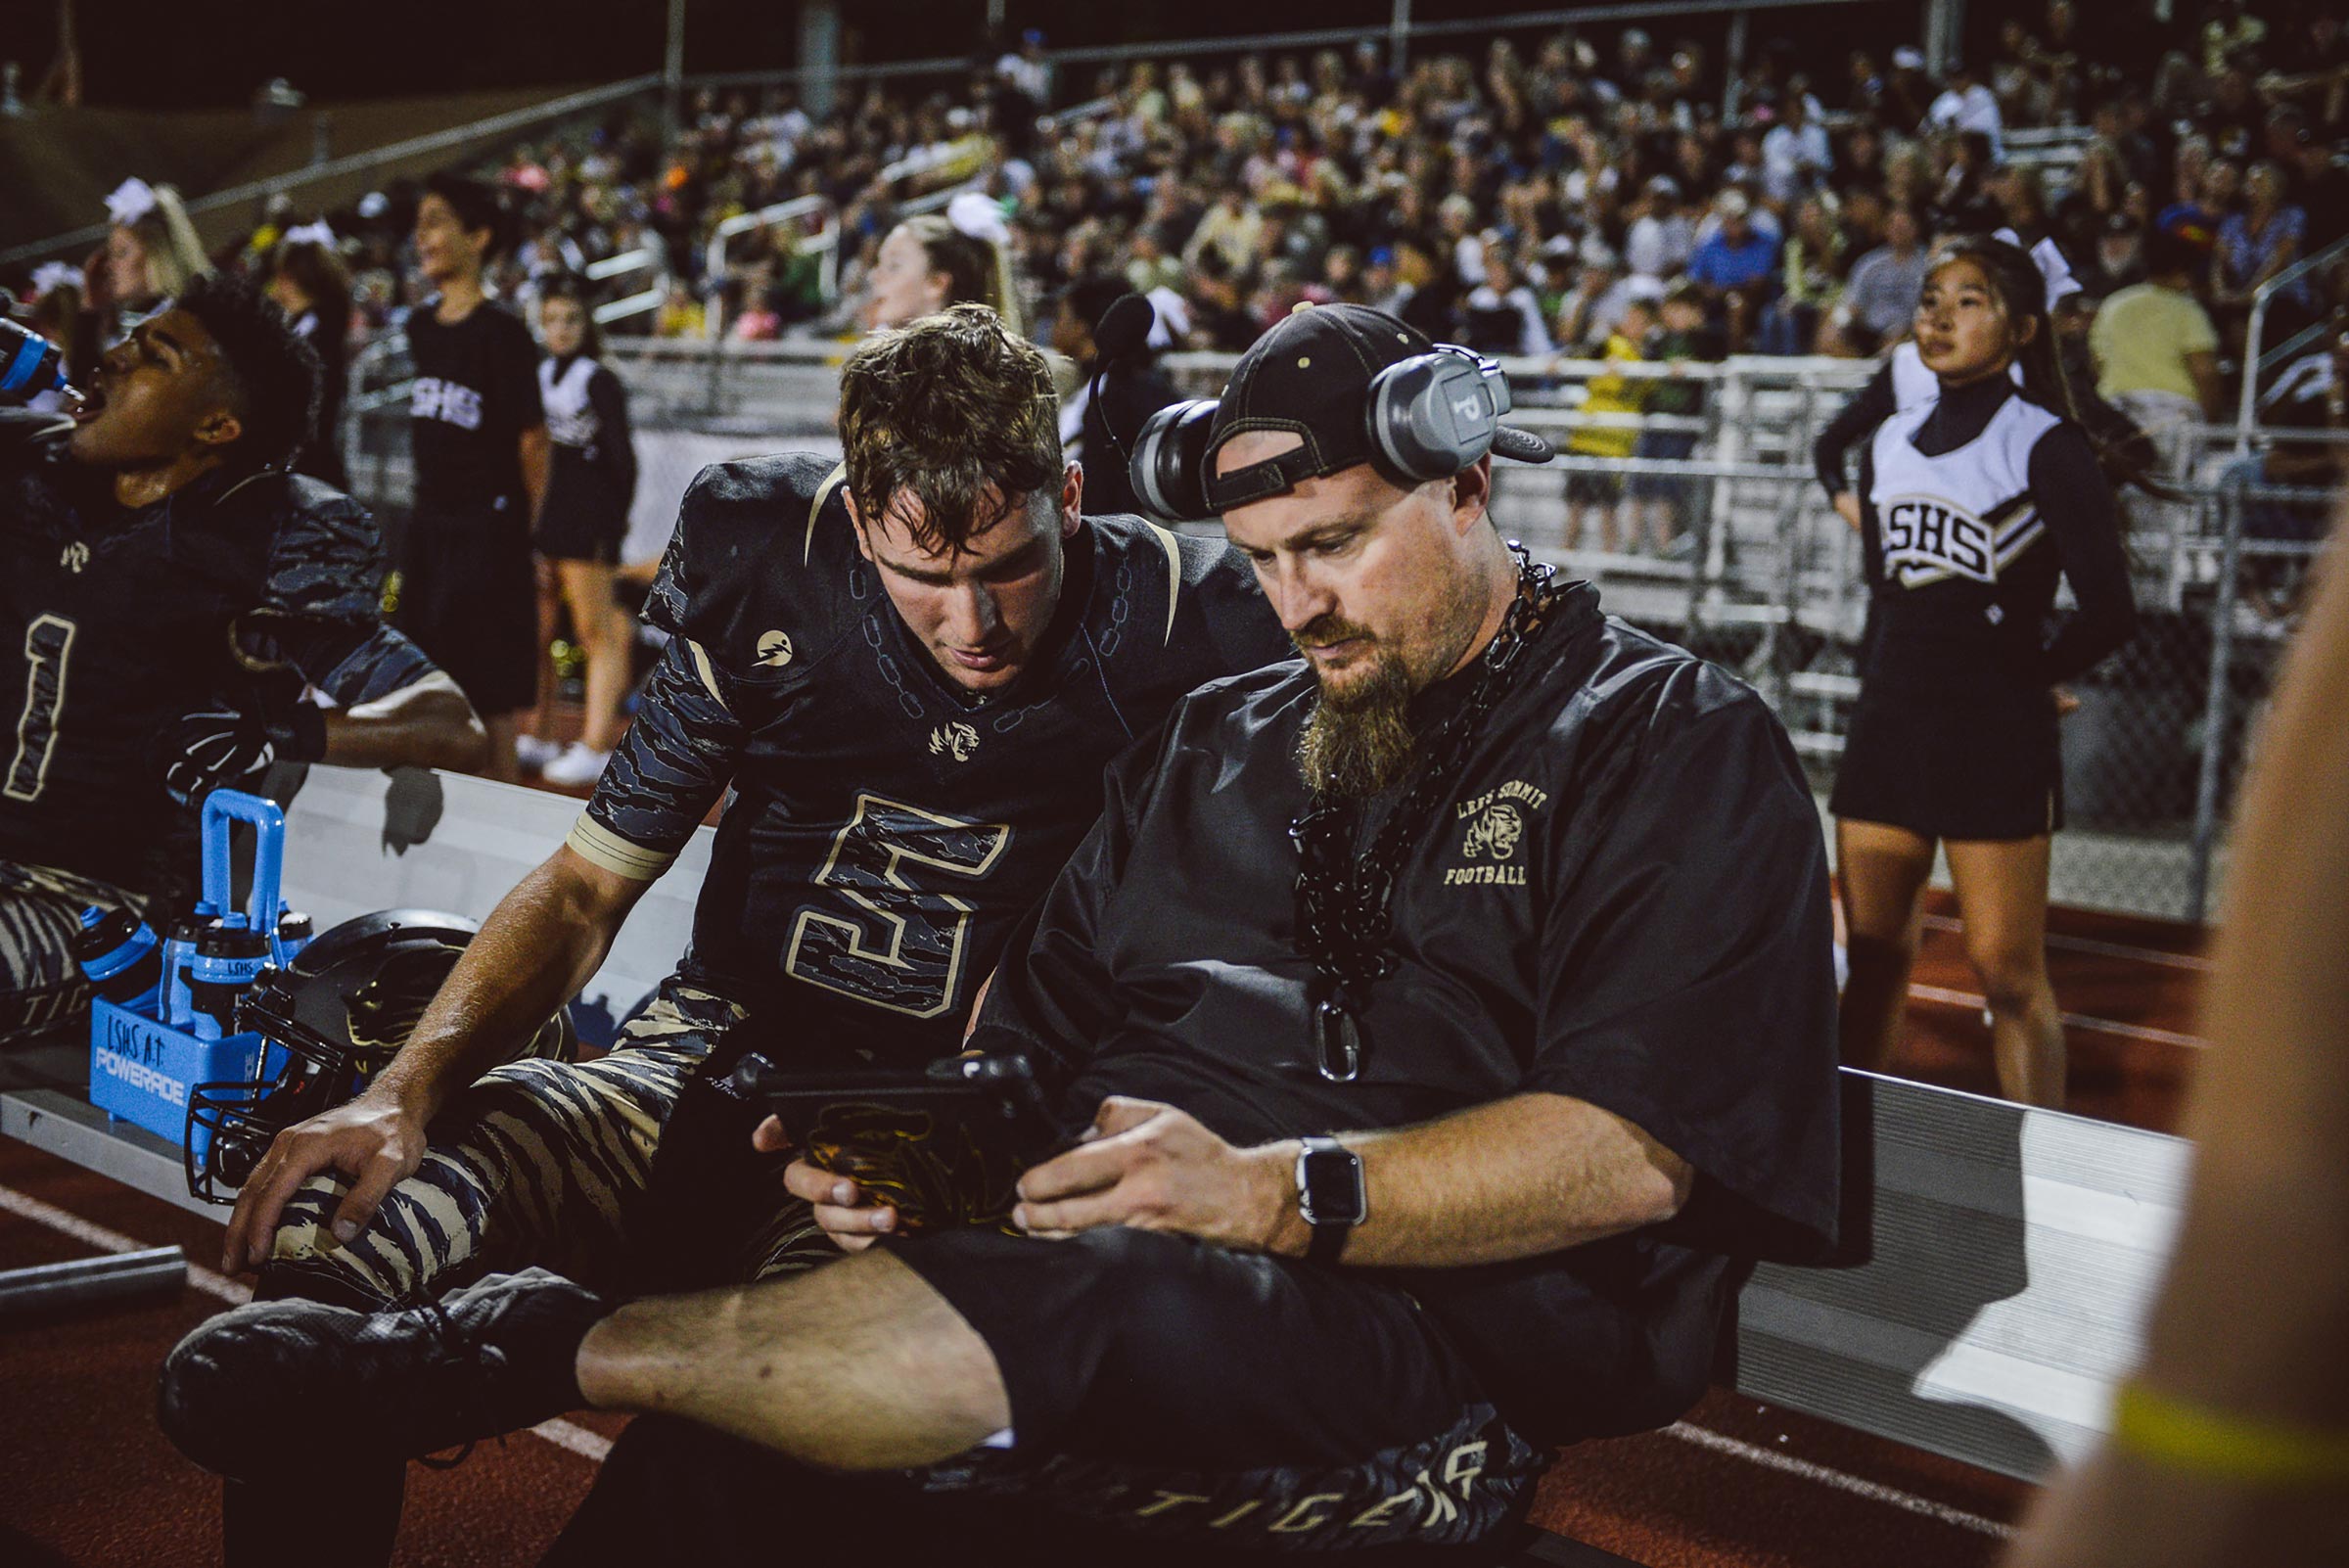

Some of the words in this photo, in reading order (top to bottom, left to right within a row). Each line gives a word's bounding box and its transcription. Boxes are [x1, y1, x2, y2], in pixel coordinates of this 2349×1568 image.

[1453, 393, 1481, 422] P
[3, 613, 76, 803] 1
[1444, 864, 1527, 885] FOOTBALL
[785, 793, 1010, 1019] 5
[108, 1015, 140, 1059] LSHS
[96, 1046, 186, 1107] POWERADE
